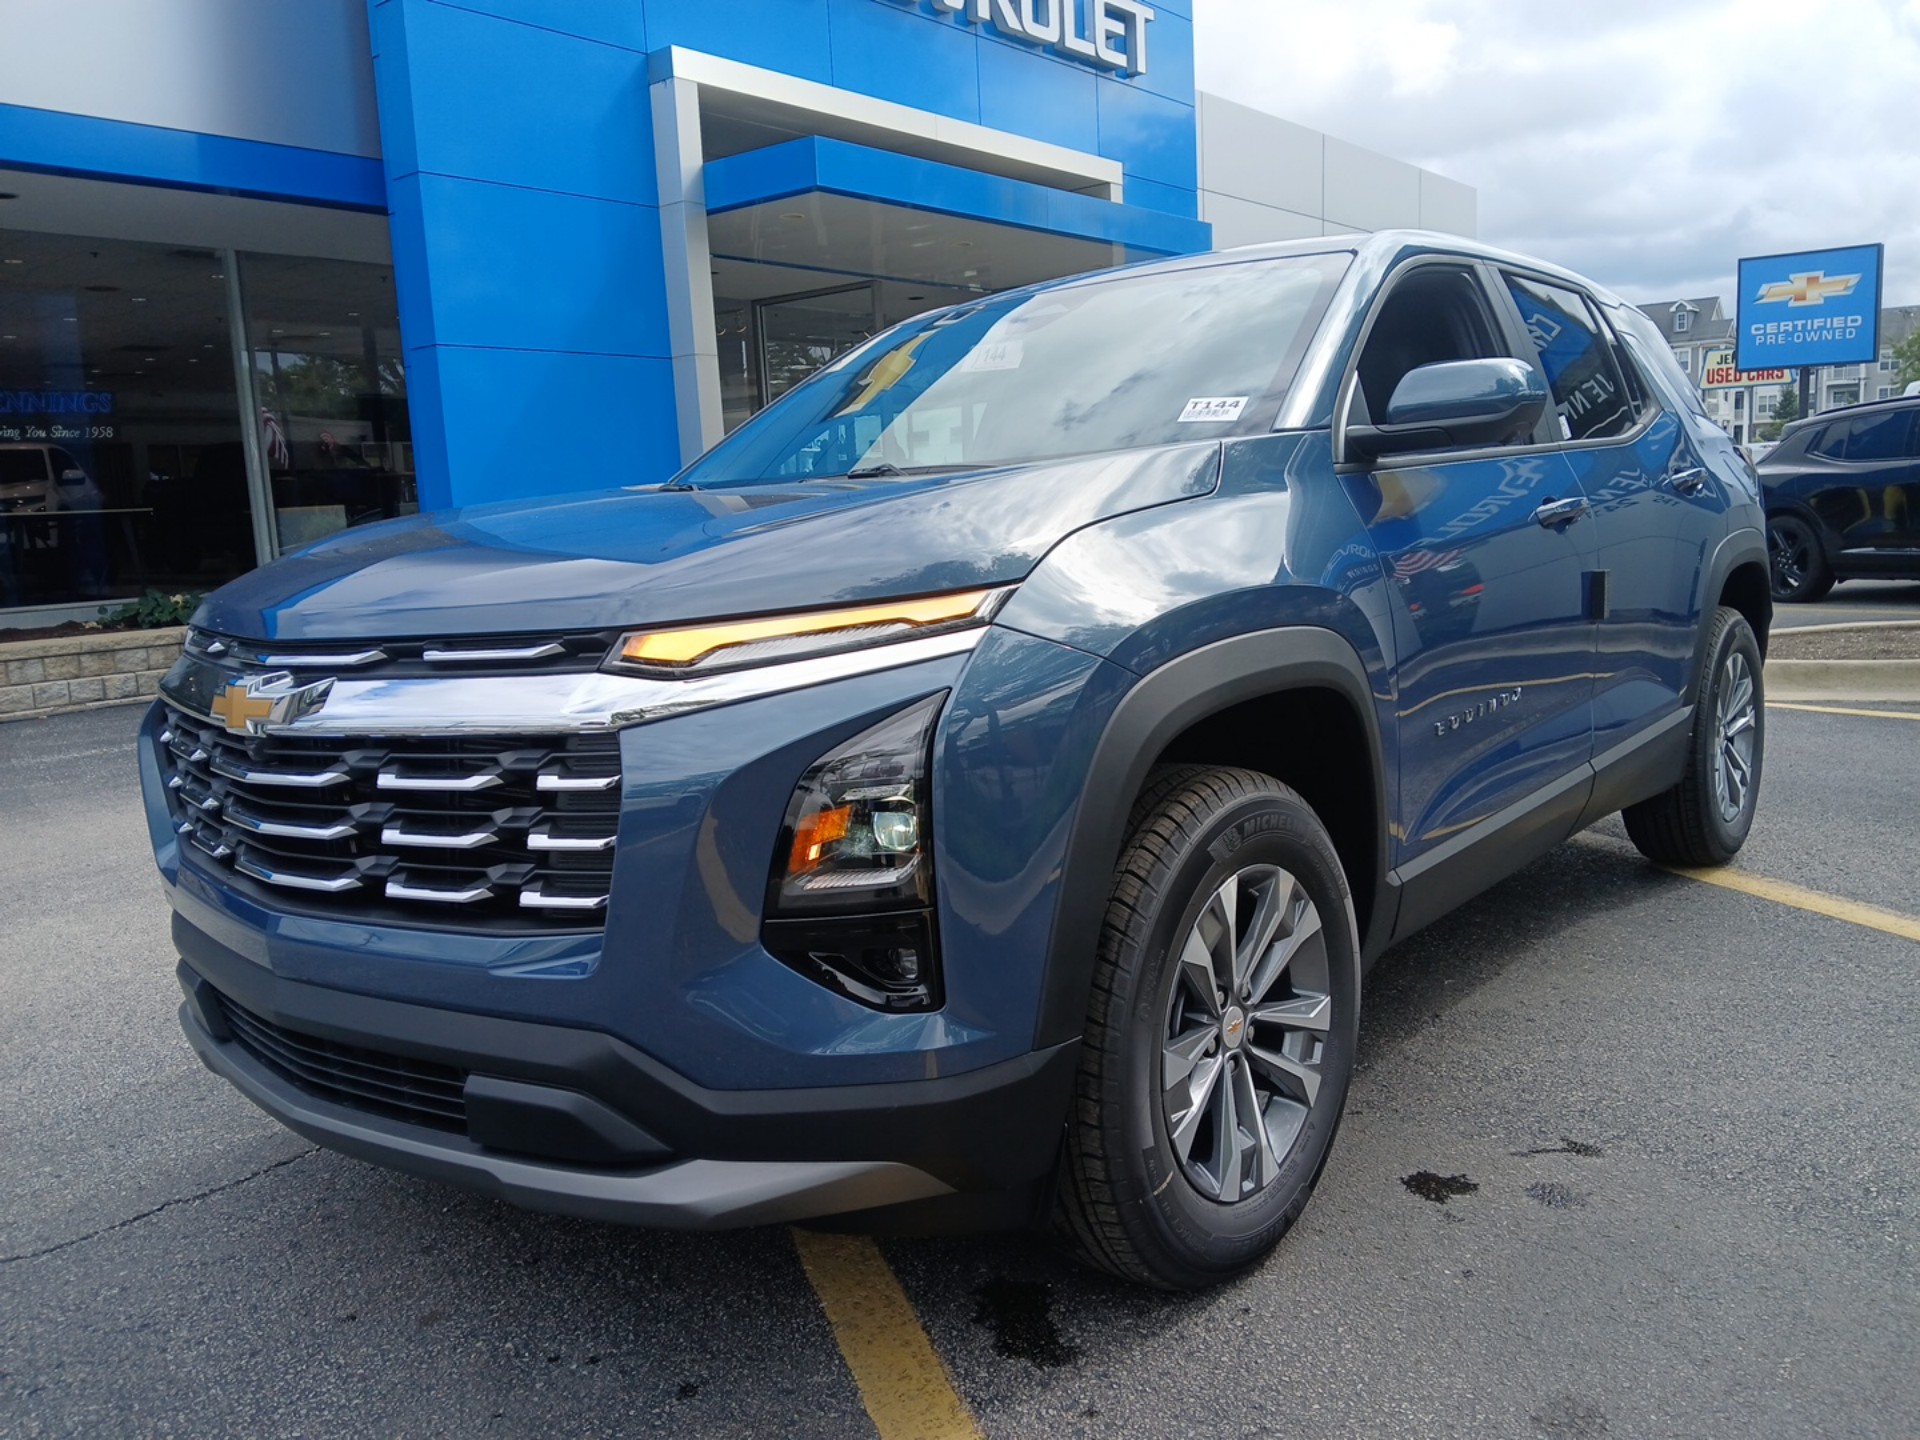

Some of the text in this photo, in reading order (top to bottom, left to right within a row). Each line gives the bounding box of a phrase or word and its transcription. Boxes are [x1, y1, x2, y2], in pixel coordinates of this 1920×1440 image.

[1751, 316, 1862, 335] CERTIFIED
[1756, 328, 1856, 346] PRE-OWNED
[1707, 367, 1785, 385] USED CARS
[1191, 400, 1240, 410] T144
[25, 425, 46, 438] You
[50, 425, 80, 438] Since
[85, 426, 114, 438] 1958
